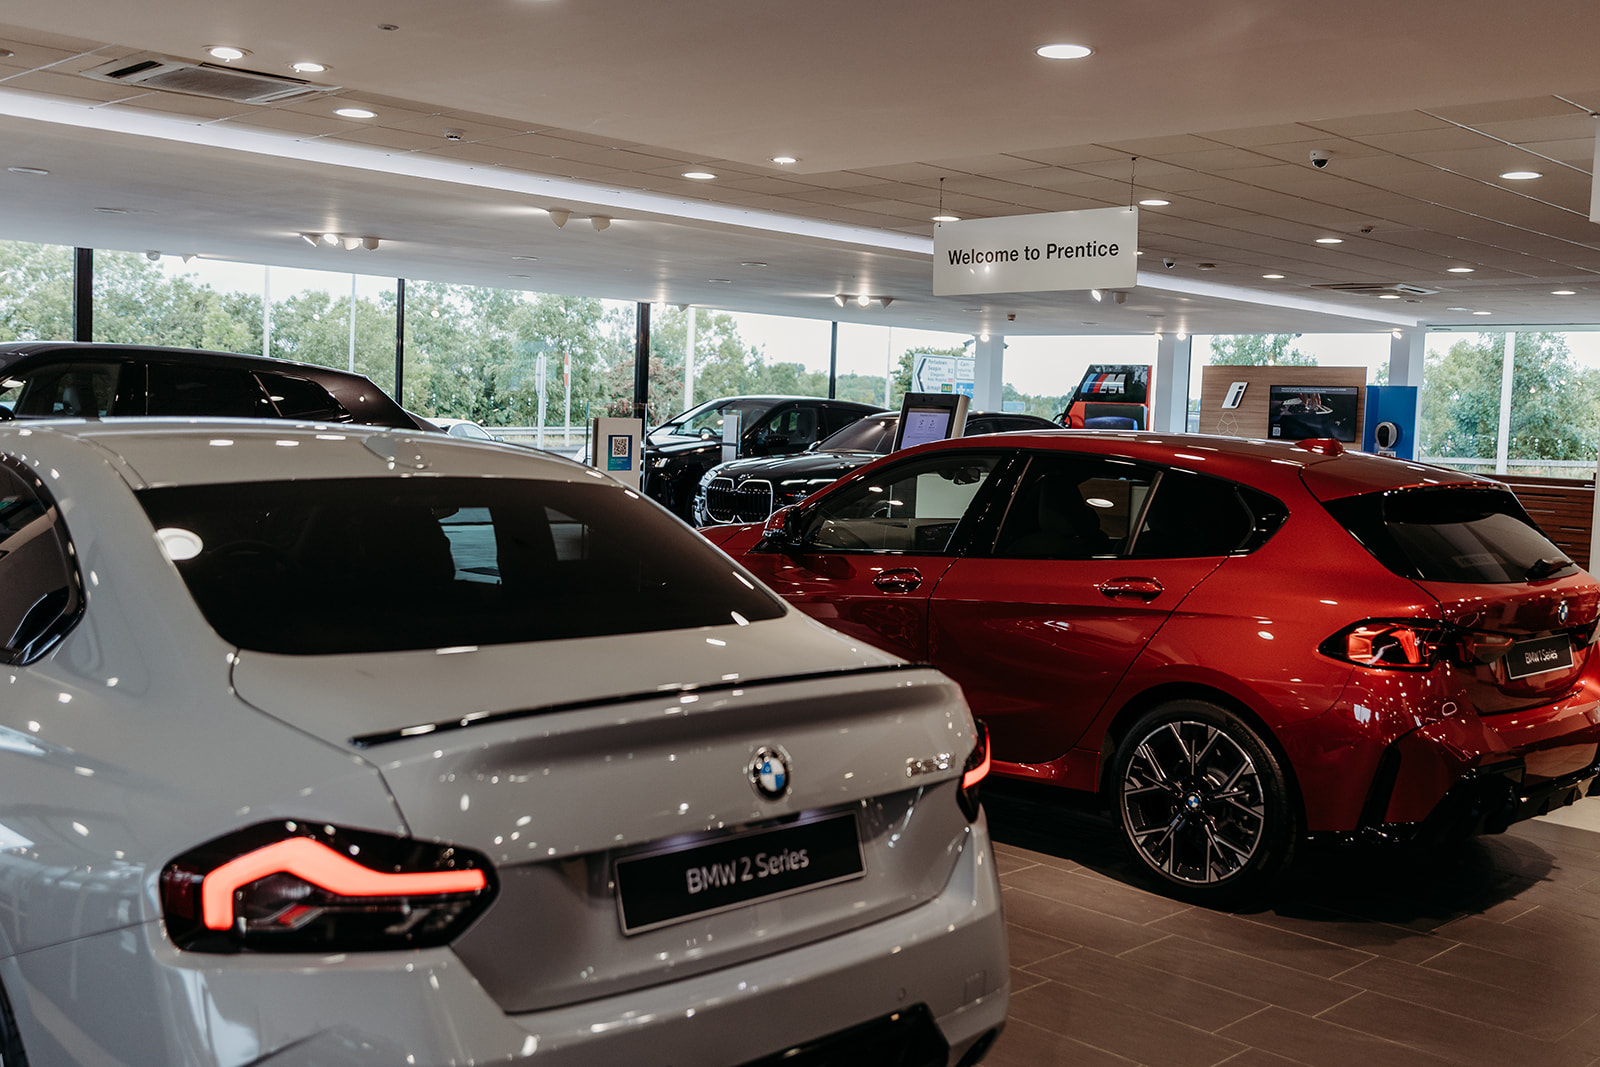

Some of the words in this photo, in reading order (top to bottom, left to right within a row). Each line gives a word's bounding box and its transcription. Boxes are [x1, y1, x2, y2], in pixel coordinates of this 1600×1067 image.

[948, 248, 1019, 265] Welcome
[1024, 246, 1040, 261] to
[1046, 241, 1119, 260] Prentice
[1525, 651, 1539, 664] BMW
[685, 860, 738, 894] BMW
[740, 856, 754, 881] 2
[756, 848, 810, 879] Series
